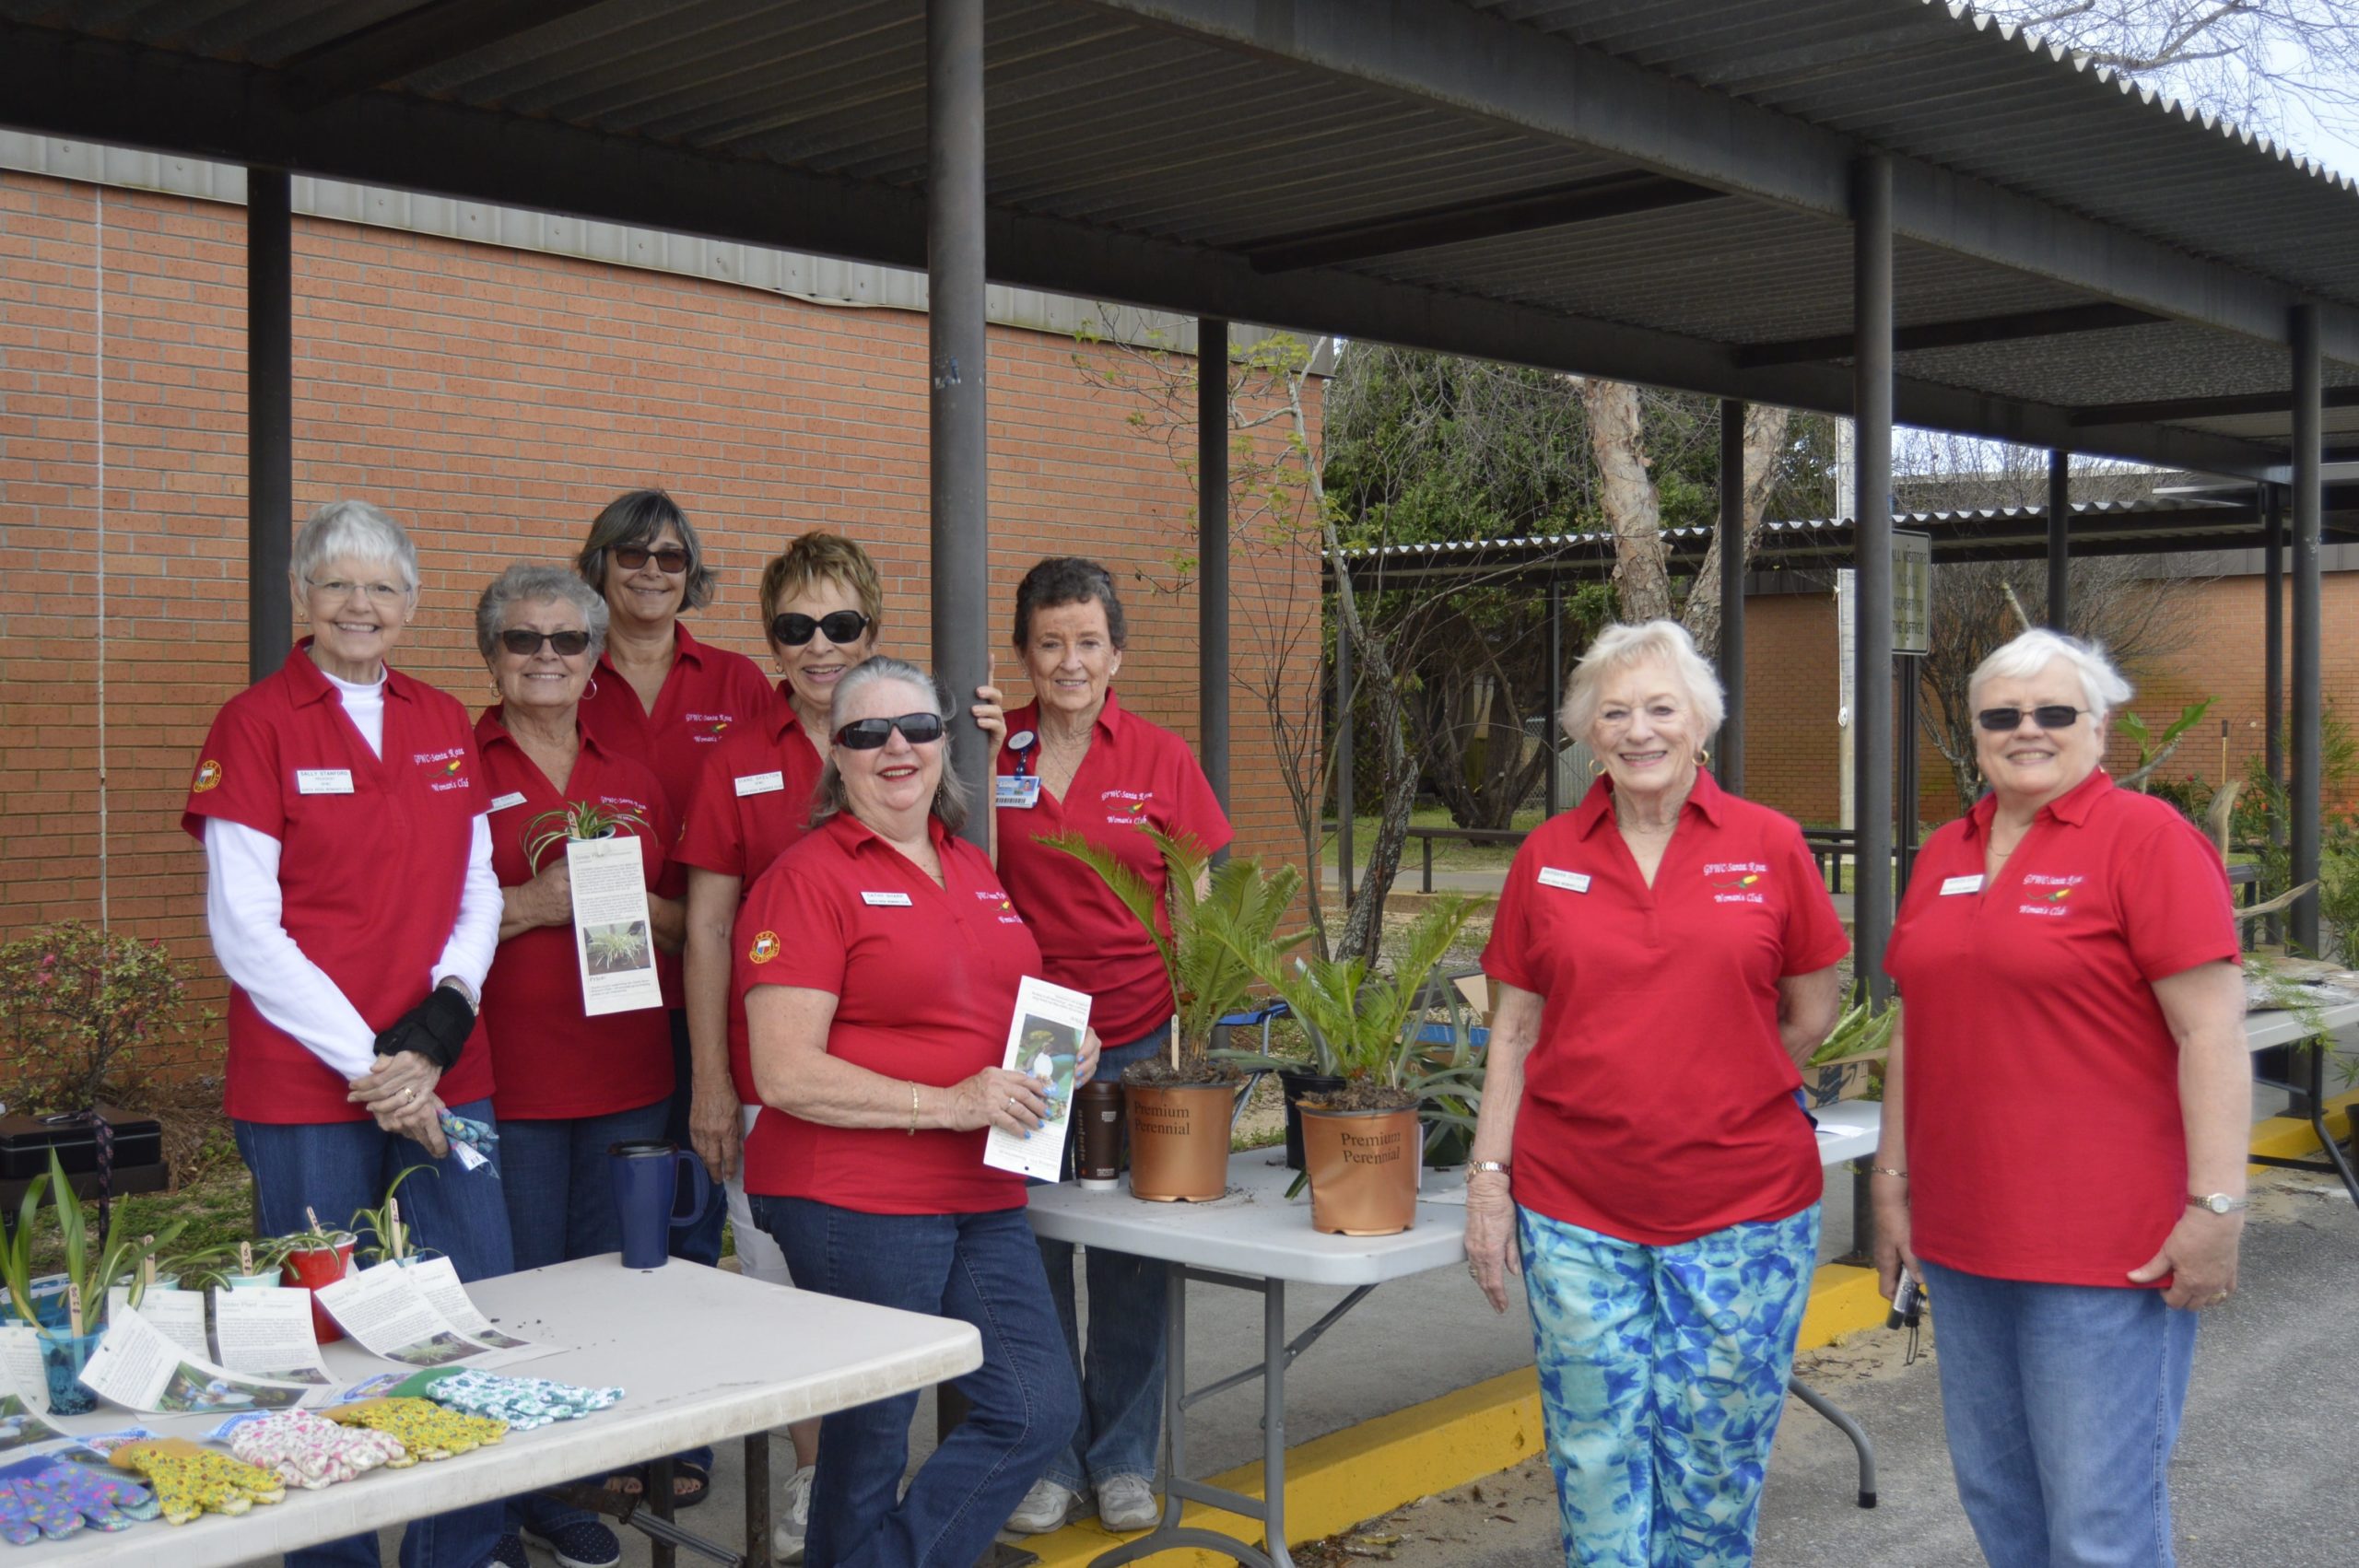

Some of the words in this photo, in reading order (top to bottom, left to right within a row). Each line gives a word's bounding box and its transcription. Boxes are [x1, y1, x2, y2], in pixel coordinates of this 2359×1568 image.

[1902, 549, 1928, 565] VISITORS
[1893, 596, 1916, 613] REPORT
[1917, 599, 1923, 613] TO
[1892, 619, 1903, 634] THE
[1904, 621, 1924, 635] OFFICE
[1746, 893, 1764, 904] Club
[1134, 1100, 1189, 1118] Premium
[1134, 1118, 1190, 1136] Perennial
[1340, 1131, 1401, 1147] Premium
[1343, 1145, 1401, 1164] Perennial
